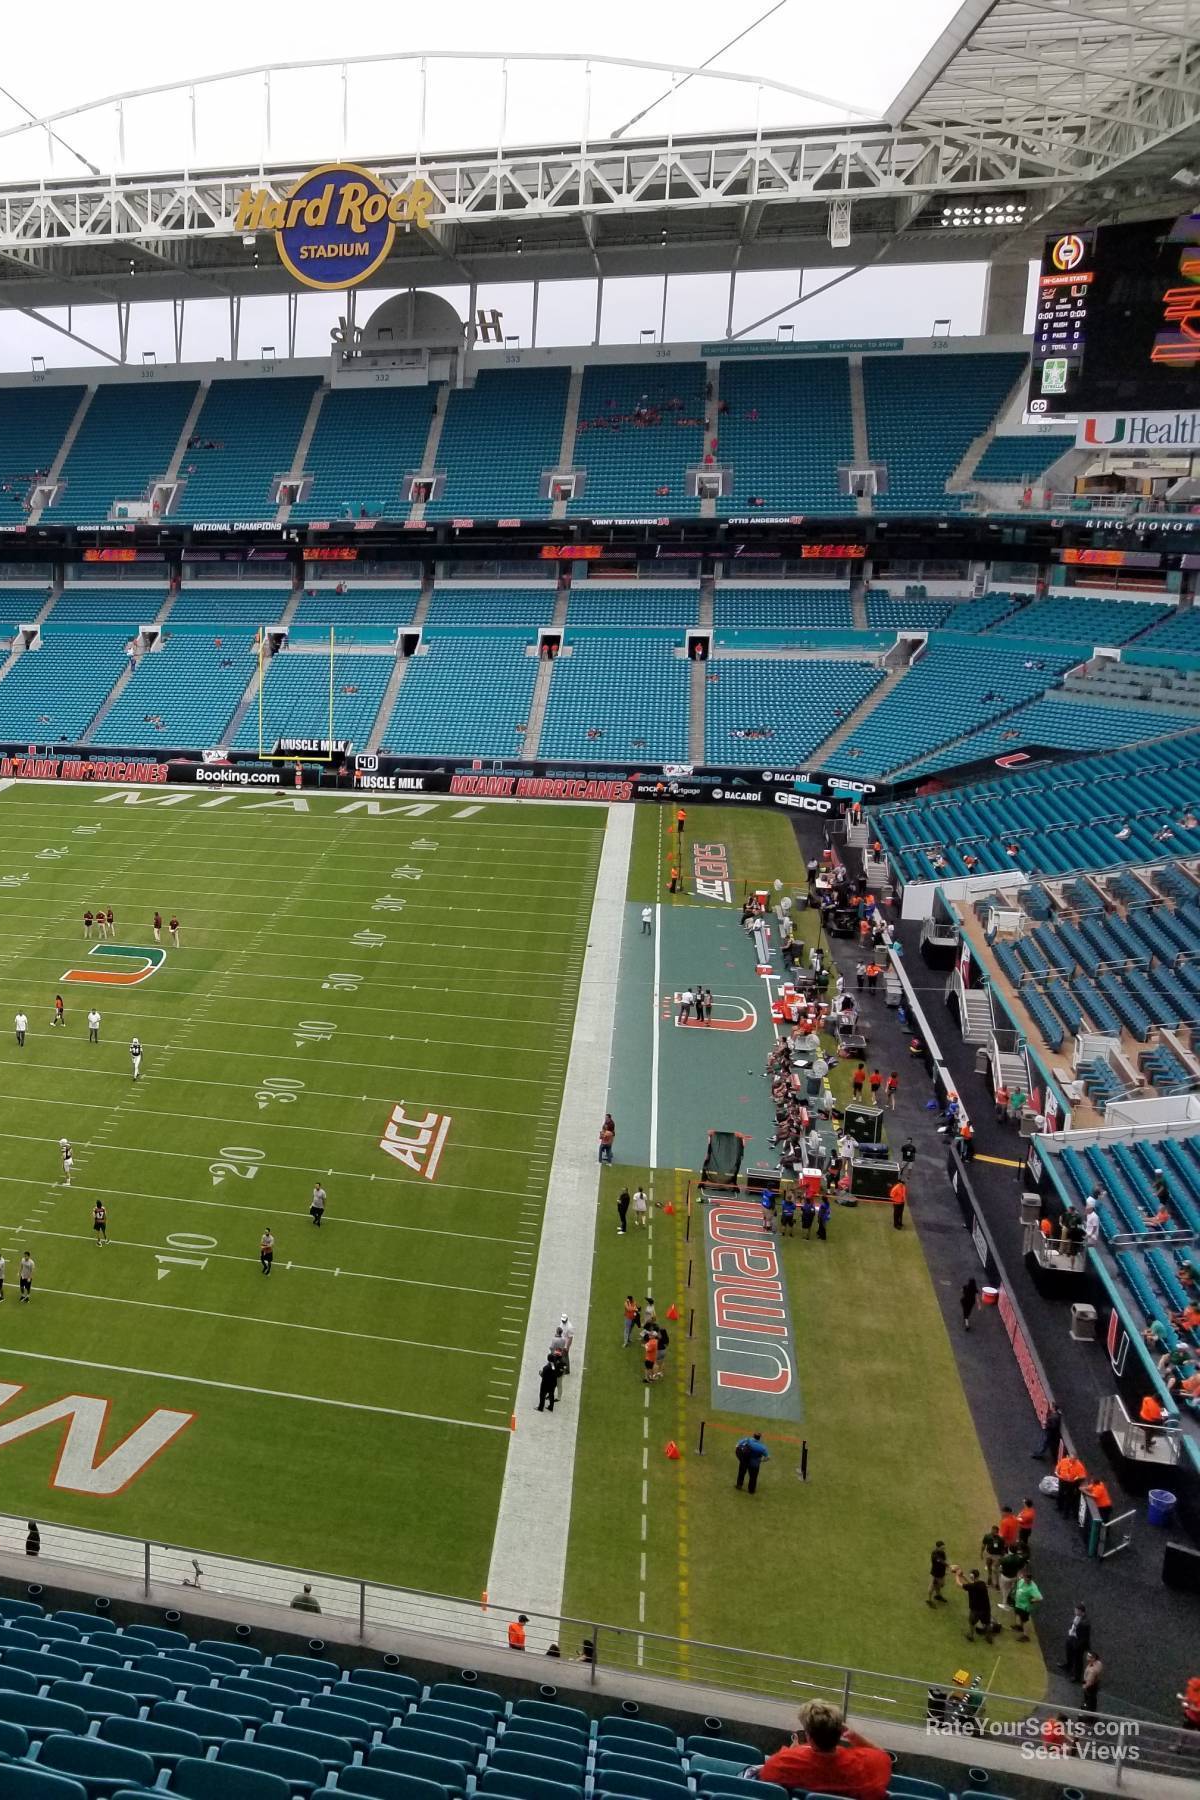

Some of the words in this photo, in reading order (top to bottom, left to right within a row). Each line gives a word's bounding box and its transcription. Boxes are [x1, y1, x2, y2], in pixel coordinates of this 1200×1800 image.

[234, 184, 333, 232] Hard
[336, 179, 434, 234] Rock
[300, 241, 369, 260] STADIUM
[1070, 310, 1086, 318] 0:00
[1032, 401, 1046, 411] CC
[193, 523, 231, 531] NATIONAL
[233, 521, 282, 531] CHAMPIONS
[1085, 520, 1124, 529] RING
[1137, 522, 1195, 531] HONOR
[281, 738, 319, 751] MUSCLE
[0, 757, 60, 778] MIAMI
[358, 757, 375, 769] 40
[196, 769, 280, 784] Booking.com
[398, 778, 424, 790] MILK
[827, 777, 876, 793] GEICO
[450, 775, 514, 796] MIAMI
[516, 777, 633, 800] HURRICANES
[638, 785, 668, 793] ROCKT
[93, 791, 486, 818] MIAMI
[774, 792, 832, 813] GEICO
[371, 898, 408, 912] 30
[349, 932, 387, 949] 40
[321, 973, 365, 992] 50
[292, 1020, 338, 1042] 40
[254, 1077, 305, 1104] 30
[379, 1104, 440, 1173] ACC
[208, 1146, 266, 1180] 20
[154, 1232, 218, 1271] 10
